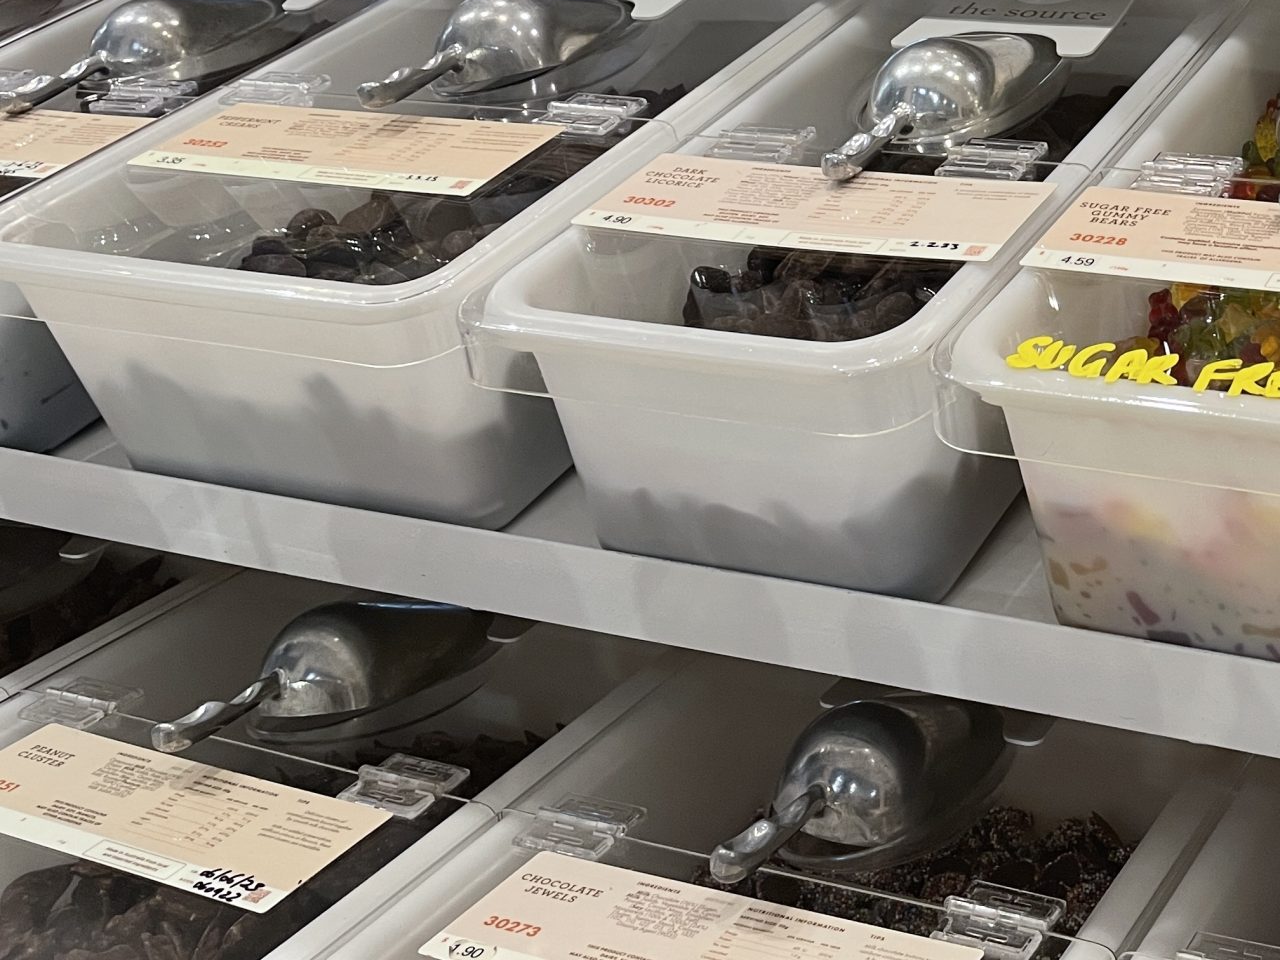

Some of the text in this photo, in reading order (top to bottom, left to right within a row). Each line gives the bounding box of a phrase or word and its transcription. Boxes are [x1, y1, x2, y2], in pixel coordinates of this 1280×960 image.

[949, 2, 1107, 21] the source
[645, 171, 721, 183] CHOCOLATE
[673, 167, 708, 175] DARK
[645, 178, 705, 189] LICORICE
[623, 196, 676, 208] 30302
[1080, 202, 1171, 216] SUGAR FREE
[603, 214, 632, 224] 4.90
[1090, 217, 1138, 227] BEARS
[1091, 210, 1149, 220] GUMMY
[1070, 233, 1128, 246] 30228
[1061, 256, 1095, 267] 4.59
[1006, 336, 1179, 386] SUGAR
[18, 751, 65, 767] CLUSTER
[30, 744, 76, 760] PEANUT
[521, 873, 604, 899] CHOCOLATE
[524, 885, 578, 904] JEWELS
[483, 915, 542, 938] 30273
[747, 907, 846, 933] NUTRITIONAL INFORMATION
[452, 943, 485, 959] 1.90
